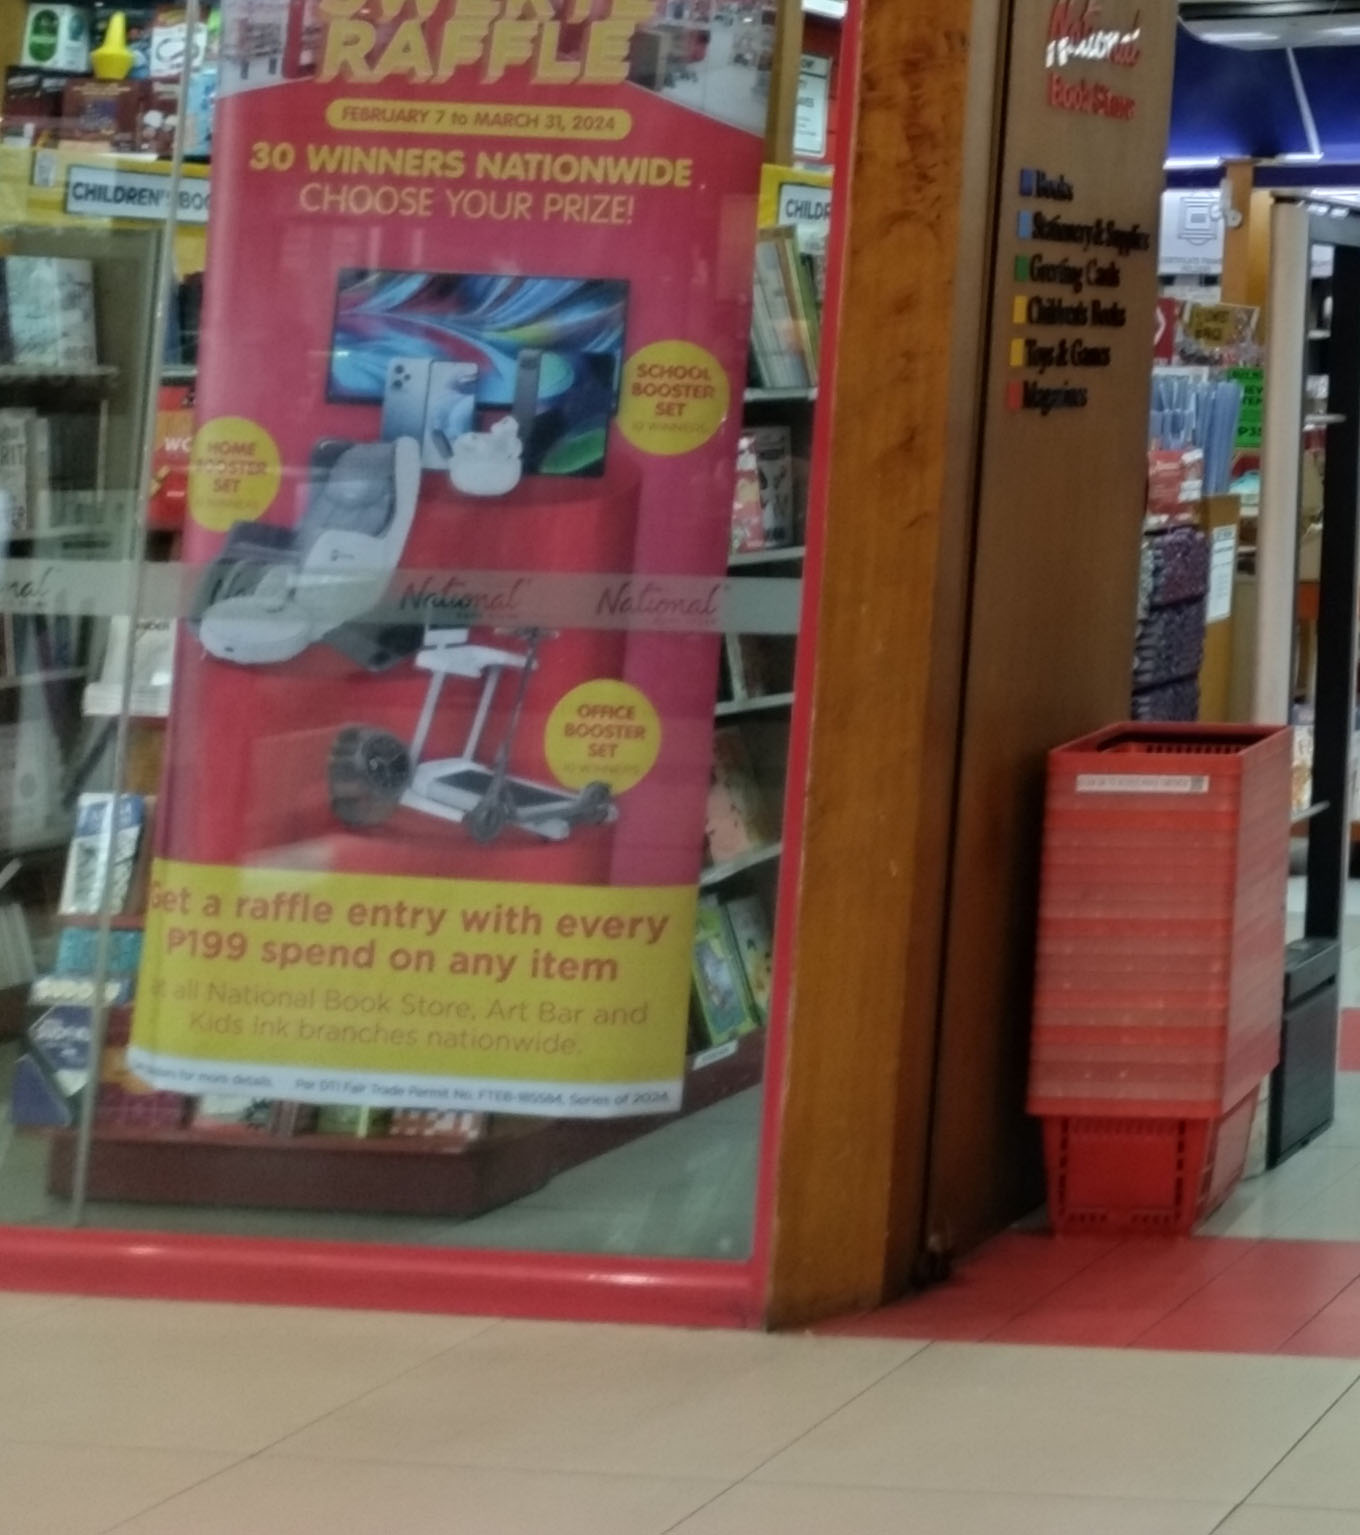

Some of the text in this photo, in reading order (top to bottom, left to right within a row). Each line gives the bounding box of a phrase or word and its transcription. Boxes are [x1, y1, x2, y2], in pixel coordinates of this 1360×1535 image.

[313, 17, 636, 86] RAFFLE
[341, 104, 616, 133] FEBRUARY 7 to MARCH 31, 2024
[250, 142, 694, 190] 30 WINNERS NATIONWIDE
[72, 181, 173, 207] CHILDREN'
[299, 182, 636, 227] CHOOSE YOUR PRIZE!
[636, 363, 712, 381] SCHOOL
[631, 382, 715, 400] BOOSTER
[655, 402, 687, 417] SET
[576, 703, 636, 721] OFFICE
[563, 722, 647, 740] BOOSTER
[587, 743, 619, 759] SET
[202, 892, 222, 918] a
[235, 889, 333, 926] raffle
[346, 899, 448, 937] entry
[460, 902, 542, 937] with
[555, 912, 670, 947] every
[260, 936, 377, 971] spend
[388, 946, 436, 973] on
[448, 948, 518, 984] any
[530, 948, 621, 983] item
[207, 979, 317, 1011] National
[324, 987, 392, 1016] Book
[400, 991, 476, 1022] Store,
[486, 996, 528, 1024] Art
[537, 999, 585, 1027] Bar
[591, 999, 651, 1028] and
[188, 1010, 244, 1037] Kids
[298, 1015, 419, 1049] branches
[426, 1022, 583, 1058] nationwide.
